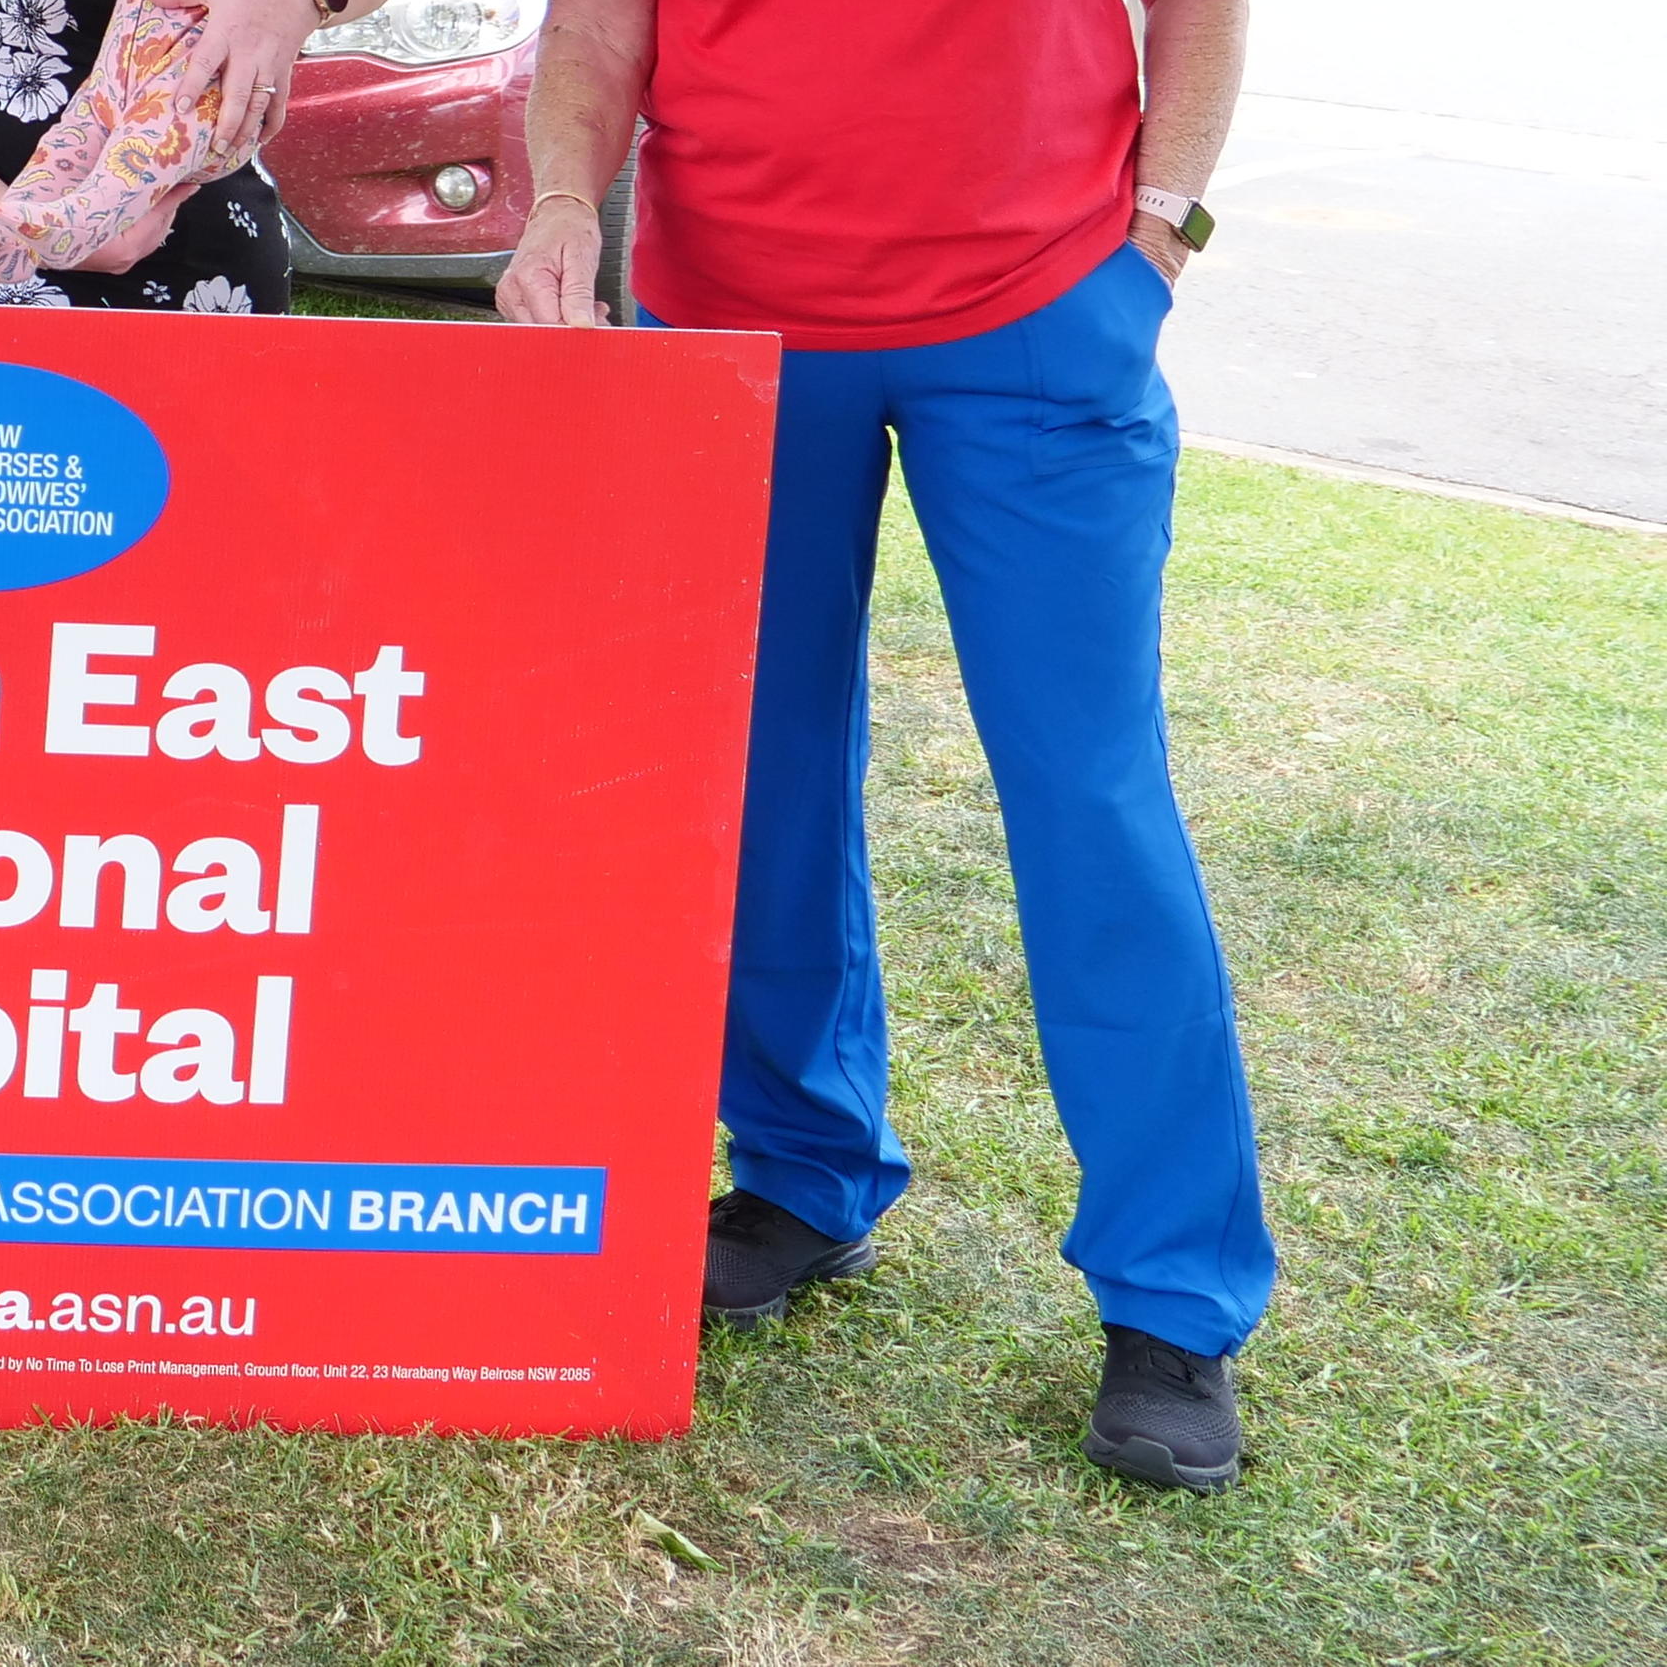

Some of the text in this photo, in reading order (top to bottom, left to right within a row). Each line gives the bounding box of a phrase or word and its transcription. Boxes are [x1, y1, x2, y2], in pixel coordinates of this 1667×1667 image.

[64, 455, 83, 480] &
[44, 622, 425, 766] East
[349, 1190, 588, 1235] BRANCH
[7, 1357, 23, 1373] by
[26, 1357, 43, 1371] No
[45, 1357, 76, 1372] Time
[78, 1358, 93, 1373] To
[95, 1359, 125, 1373] Lose
[127, 1359, 156, 1374] Print
[158, 1360, 241, 1378] Management,
[244, 1362, 289, 1377] Ground
[291, 1363, 320, 1378] floor,
[323, 1364, 348, 1378] Unit
[350, 1364, 369, 1379] 22,
[372, 1365, 389, 1379] 23
[391, 1365, 450, 1382] Narabang
[452, 1366, 478, 1382] Way
[480, 1366, 525, 1381] Belrose
[527, 1367, 557, 1381] NSW
[559, 1367, 591, 1381] 2085
